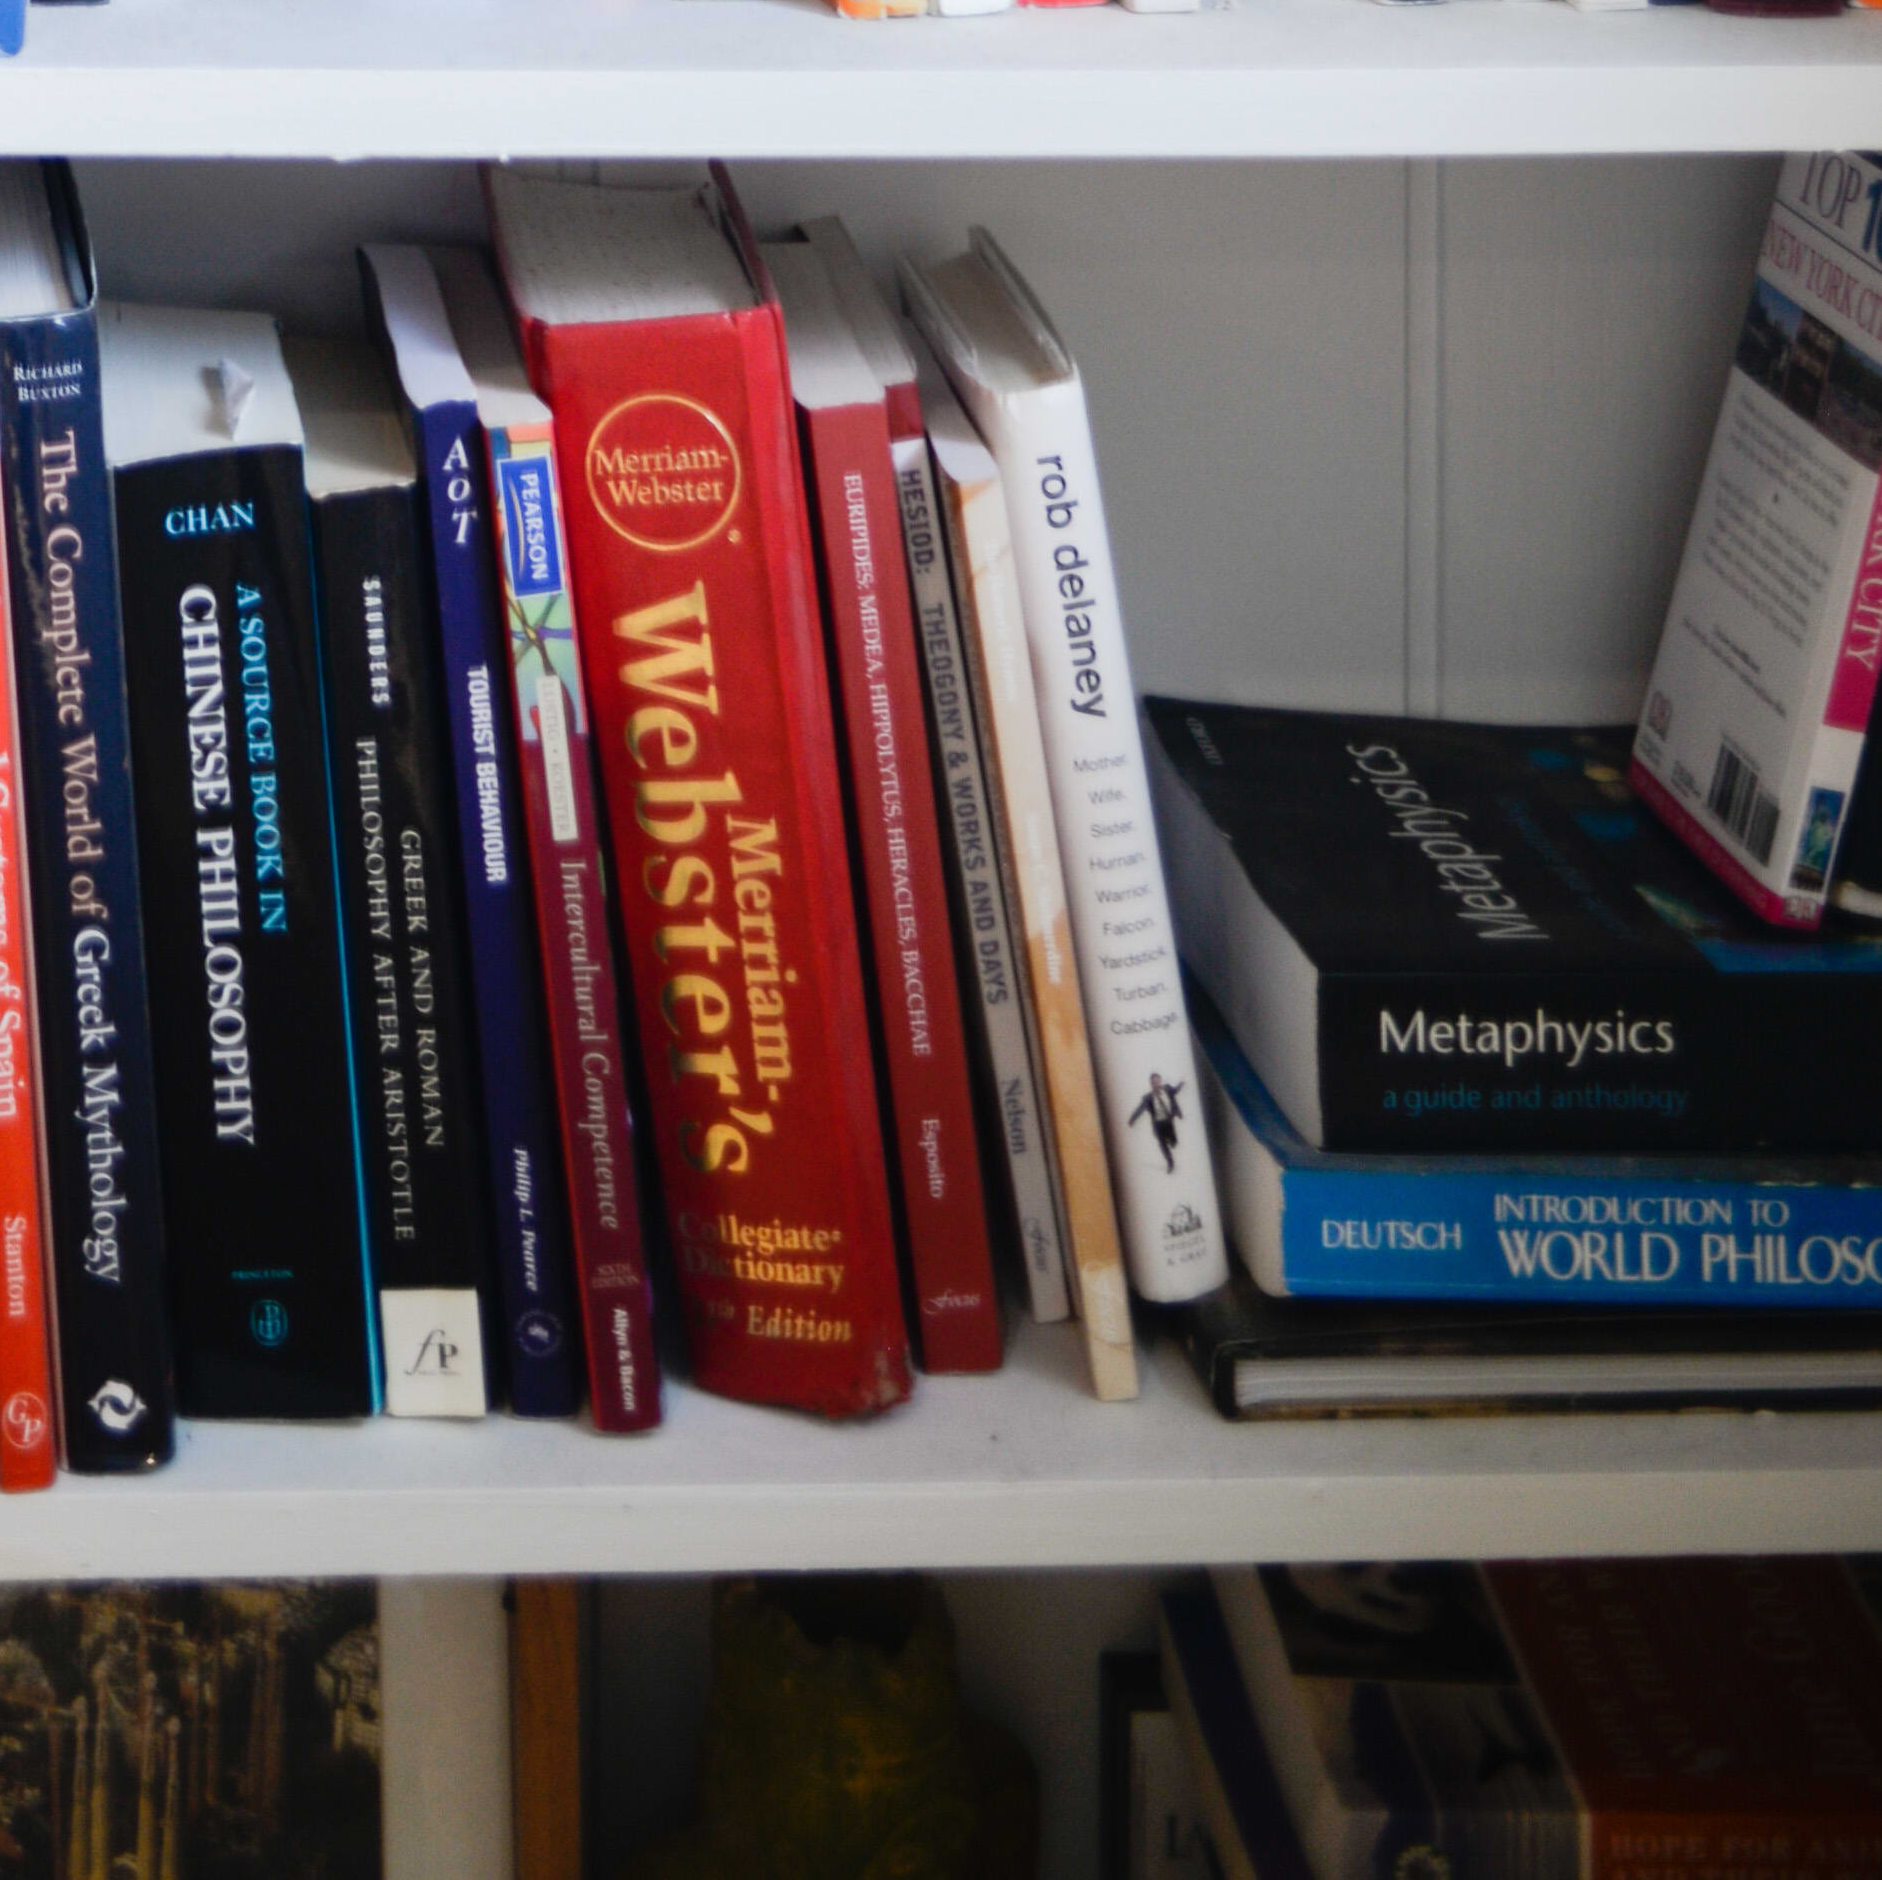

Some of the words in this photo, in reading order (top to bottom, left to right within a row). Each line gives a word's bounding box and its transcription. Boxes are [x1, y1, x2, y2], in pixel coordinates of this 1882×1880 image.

[39, 430, 78, 513] The
[595, 447, 730, 477] Merriam-
[604, 478, 726, 504] Webster
[1035, 454, 1079, 530] rob
[165, 502, 256, 535] CHAN
[519, 472, 549, 581] PEARSON
[39, 526, 85, 725] Complete
[361, 576, 392, 705] SAUNDERS
[920, 603, 965, 740] THEOGONY
[1053, 544, 1109, 720] delaney
[179, 584, 233, 813] CHINESE
[238, 616, 276, 763] SOURCE
[466, 665, 497, 755] TOURIST
[62, 732, 105, 860] World
[843, 474, 876, 590] EURIPIDES:
[899, 949, 933, 1057] BACCHAE
[947, 751, 970, 774] &
[249, 774, 285, 880] BOOK
[355, 738, 392, 940] PHILOSOPHY
[474, 762, 508, 884] BEHAVIOUR
[950, 777, 985, 872] WORKS
[1347, 743, 1550, 940] Metaphysics
[67, 874, 106, 919] of
[258, 888, 288, 934] IN
[399, 830, 429, 933] GREEK
[611, 579, 776, 1177] Webster's
[967, 878, 996, 937] AND
[72, 928, 114, 1050] Greek
[196, 826, 256, 1146] PHILOSOPHY
[408, 946, 433, 1014] AND
[559, 859, 611, 1042] Intercultural
[723, 813, 799, 1102] Merriam-
[977, 940, 1009, 1006] DAYS
[371, 954, 403, 1055] AFTER
[1377, 1008, 1675, 1067] Metaphysics
[414, 1028, 447, 1148] ROMAN
[998, 1079, 1029, 1155] Nelson
[74, 1062, 129, 1283] Mythology
[382, 1067, 416, 1242] ARISTOTLE
[512, 1148, 533, 1203] Philip
[577, 1051, 622, 1231] Competence
[919, 1118, 947, 1199] Esposito
[520, 1229, 540, 1292] Pearce
[1320, 1219, 1464, 1251] DEUTSCH
[1493, 1193, 1732, 1226] INTRODUCTION
[1746, 1201, 1790, 1228] TO
[1497, 1228, 1679, 1283] WORLD
[3, 1215, 29, 1317] Stanton
[611, 1307, 631, 1346] Allyn
[619, 1364, 638, 1412] Bacon
